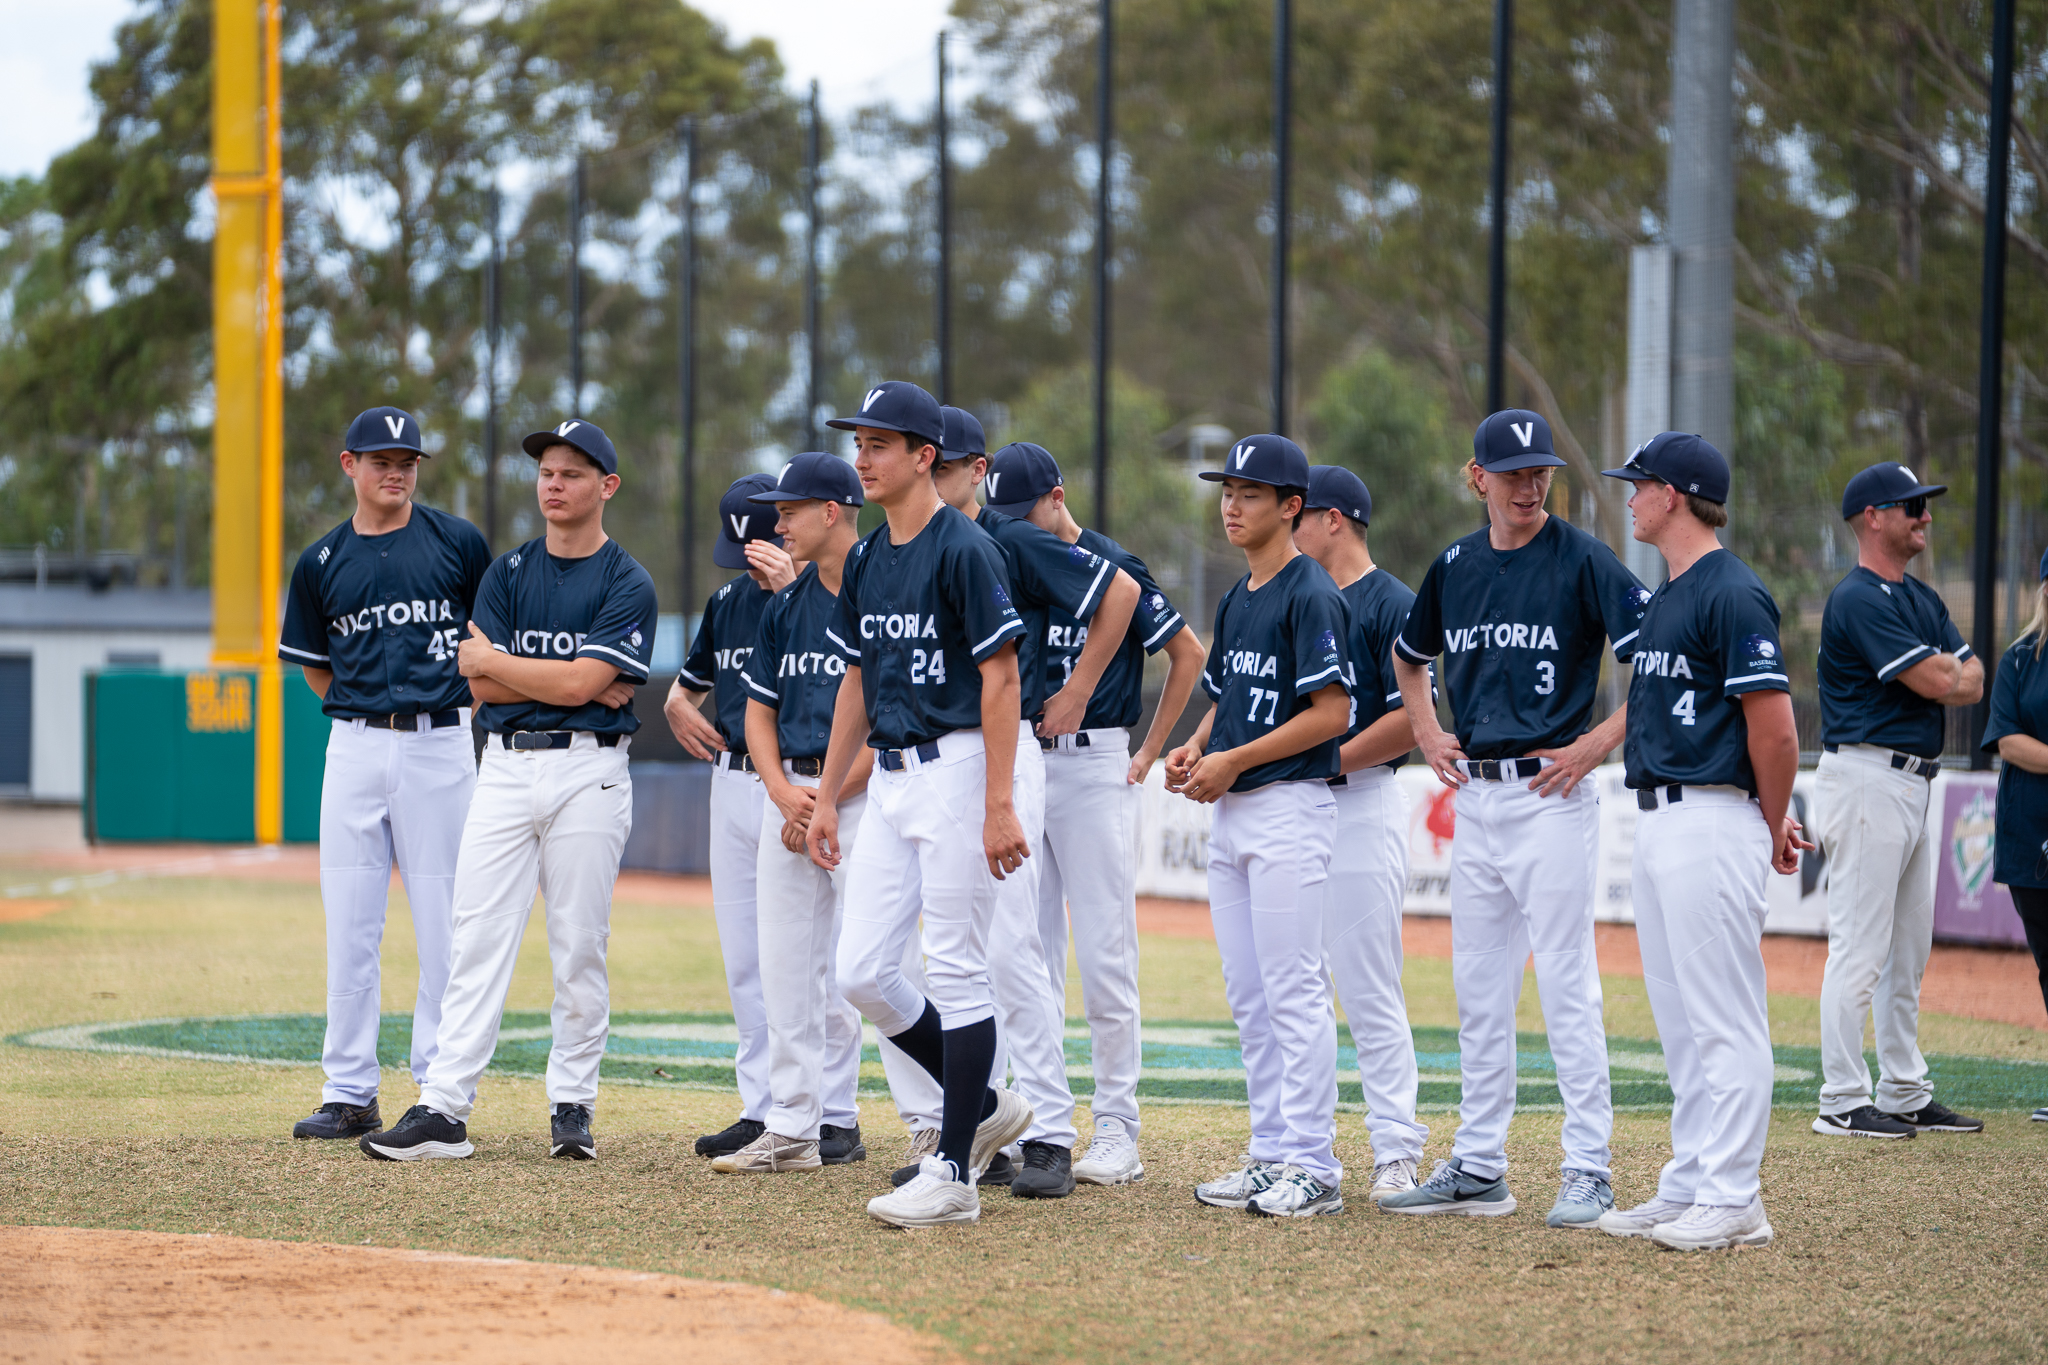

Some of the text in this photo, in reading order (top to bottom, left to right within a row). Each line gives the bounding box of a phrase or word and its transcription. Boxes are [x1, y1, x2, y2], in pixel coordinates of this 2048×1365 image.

[861, 388, 886, 413] V
[384, 415, 406, 440] V
[557, 420, 581, 438] V
[1509, 421, 1534, 448] V
[1234, 444, 1257, 471] V
[984, 472, 1001, 499] V
[729, 513, 750, 539] V
[332, 599, 454, 637] VICTORIA
[427, 627, 459, 662] 45
[1445, 622, 1560, 653] VICTORIA
[910, 648, 946, 685] 24
[1222, 649, 1277, 680] TORIA
[1534, 660, 1556, 695] 3
[1749, 660, 1778, 668] BASEBALL
[1247, 686, 1280, 725] 77
[1672, 689, 1696, 726] 4
